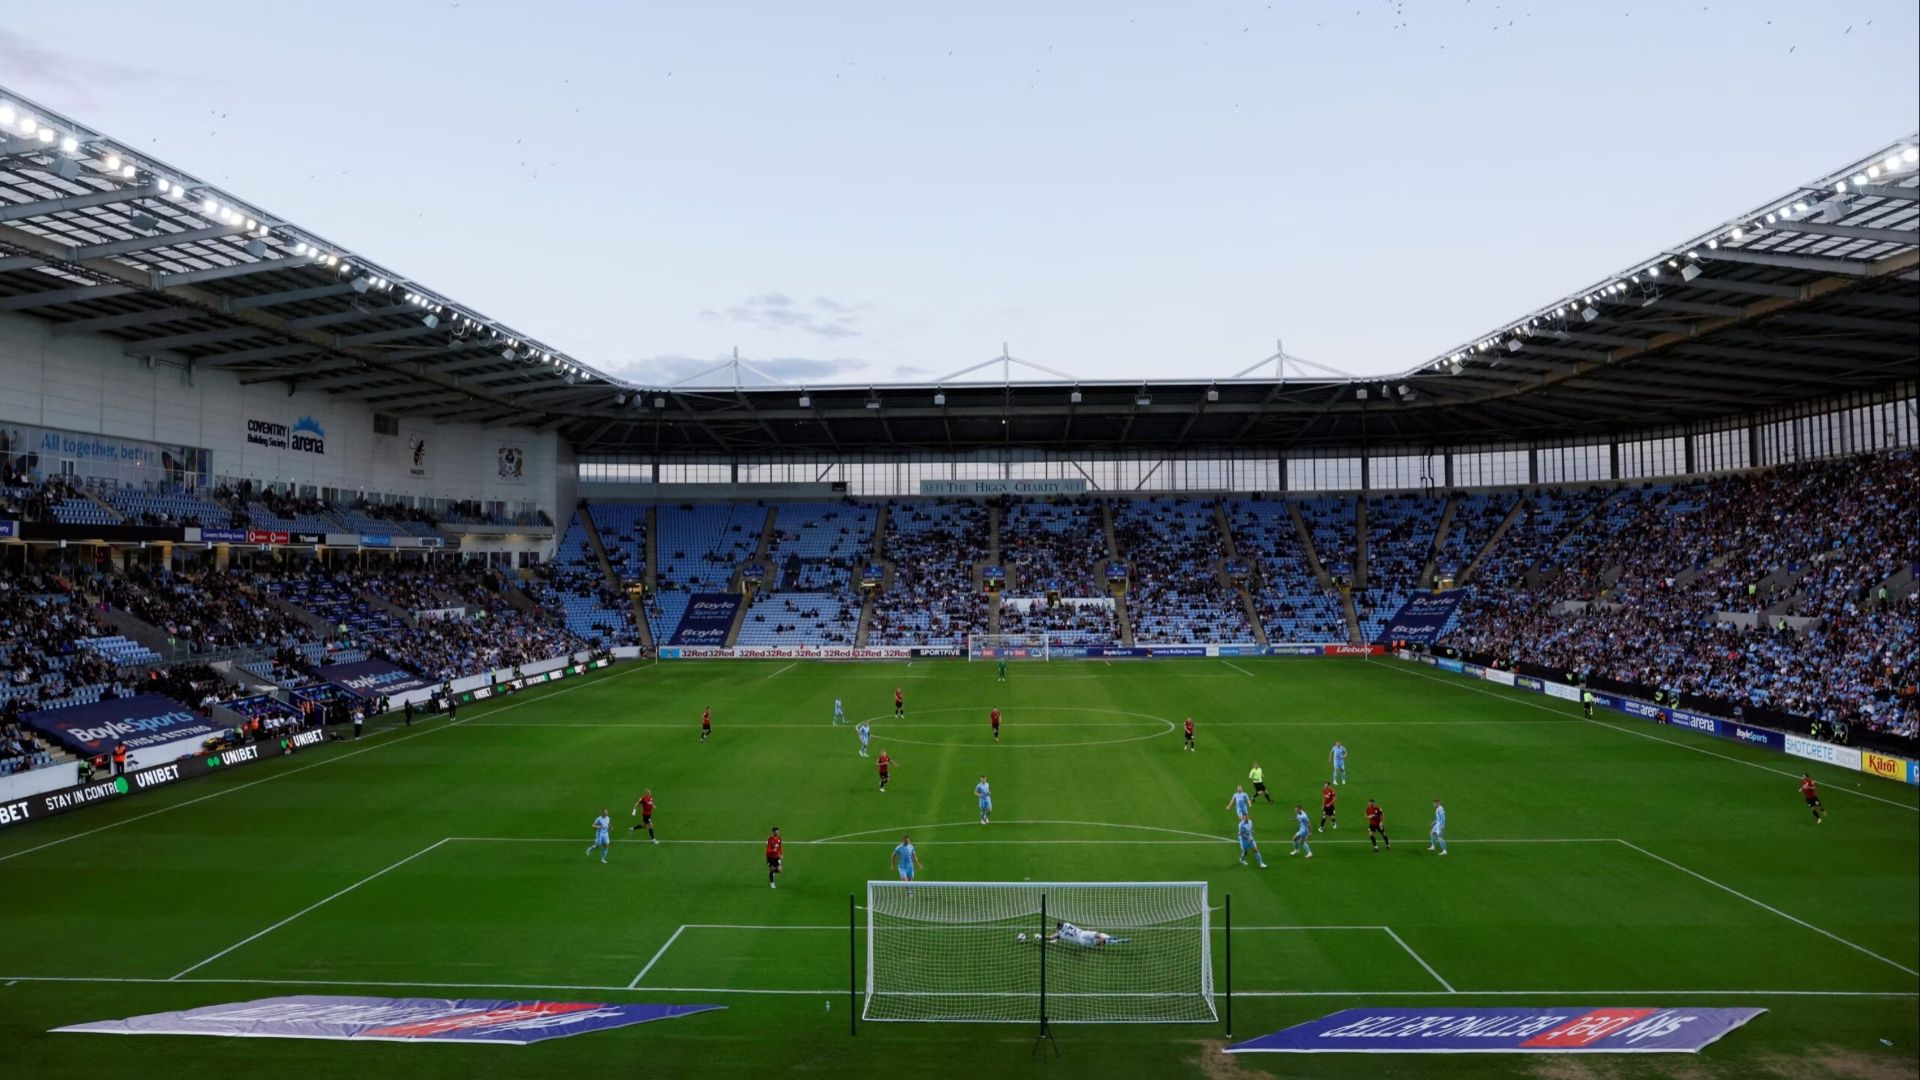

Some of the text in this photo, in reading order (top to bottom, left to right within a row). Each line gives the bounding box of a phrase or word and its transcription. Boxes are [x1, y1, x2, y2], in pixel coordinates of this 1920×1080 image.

[248, 419, 287, 437] COVENTRY
[41, 432, 60, 451] All
[63, 438, 118, 462] together,
[292, 434, 325, 455] arena
[975, 482, 1008, 492] HIGGS
[1014, 482, 1059, 492] CHARITY
[693, 601, 736, 609] Boyle
[682, 628, 724, 637] Boyle
[682, 649, 708, 657] 32Red
[708, 649, 735, 657] 32Red
[739, 649, 765, 657] 32Red
[766, 649, 792, 657] 32Red
[795, 649, 821, 657] 32Red
[824, 649, 850, 657] 32Red
[884, 649, 911, 657] 32Red
[1336, 646, 1373, 654] Lifebuoy
[1640, 704, 1660, 718] aren
[67, 711, 194, 743] BoyleSports
[1690, 715, 1715, 733] arena
[292, 728, 323, 748] UNIBET
[1736, 728, 1768, 744] BoyleSports
[222, 745, 259, 766] UNIBET
[1786, 738, 1833, 761] SHOTCRETE
[135, 764, 180, 788] UNIBET
[45, 780, 121, 811] STAY IN CONTR
[1318, 1009, 1699, 1044] sky bet BETTING BETTER
